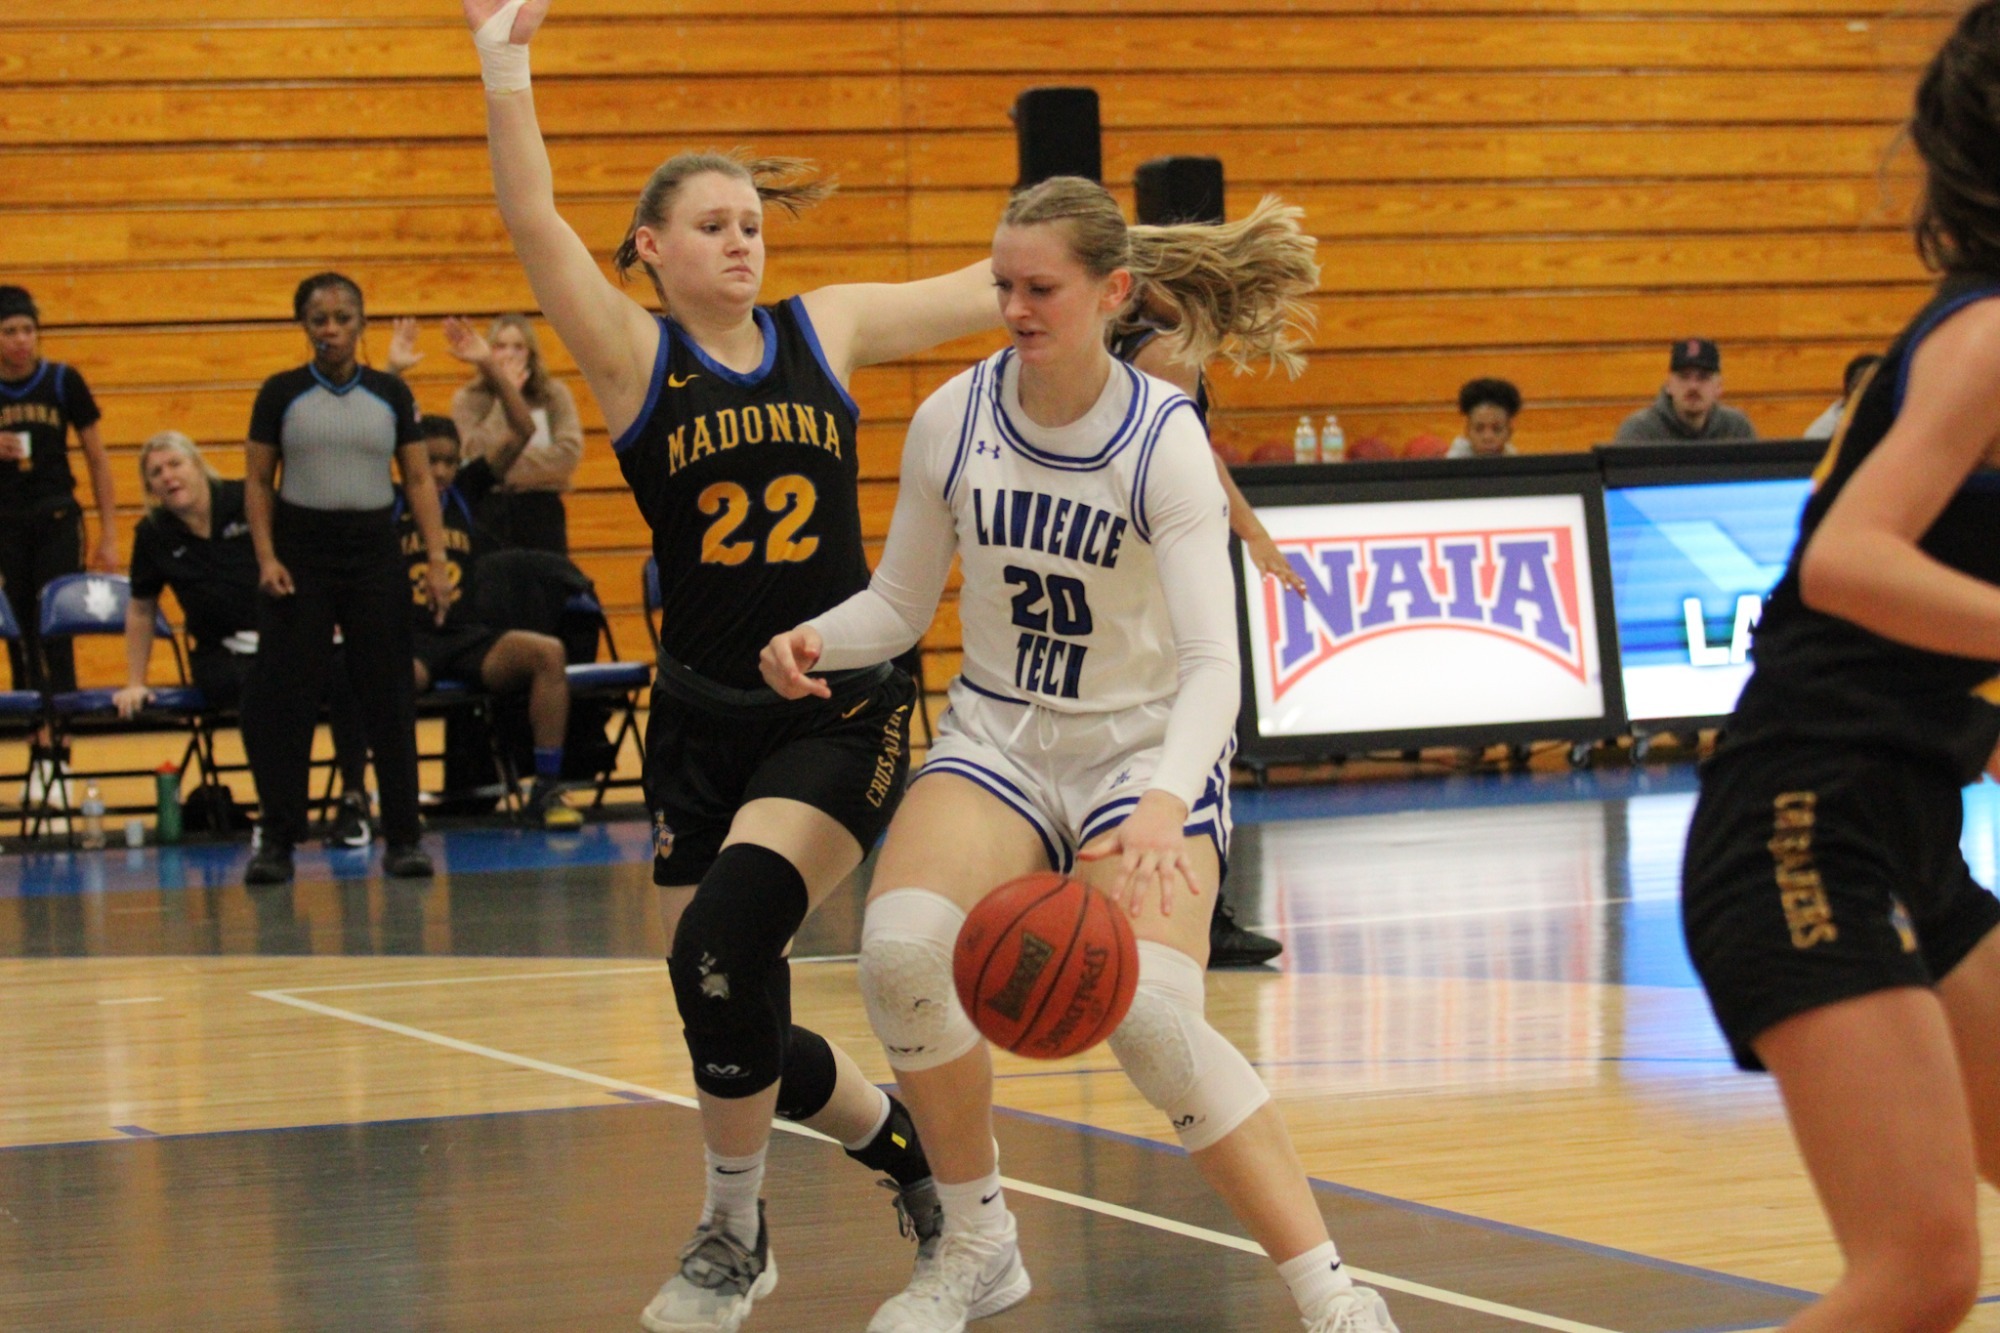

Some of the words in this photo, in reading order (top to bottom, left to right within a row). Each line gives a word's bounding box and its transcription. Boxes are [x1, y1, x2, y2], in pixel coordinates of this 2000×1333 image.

[667, 402, 842, 477] MADONNA
[697, 474, 820, 567] 22
[973, 488, 1128, 569] LAWRENCE
[1003, 564, 1093, 636] 20
[1279, 540, 1572, 672] NAIA
[1015, 632, 1088, 699] TECH
